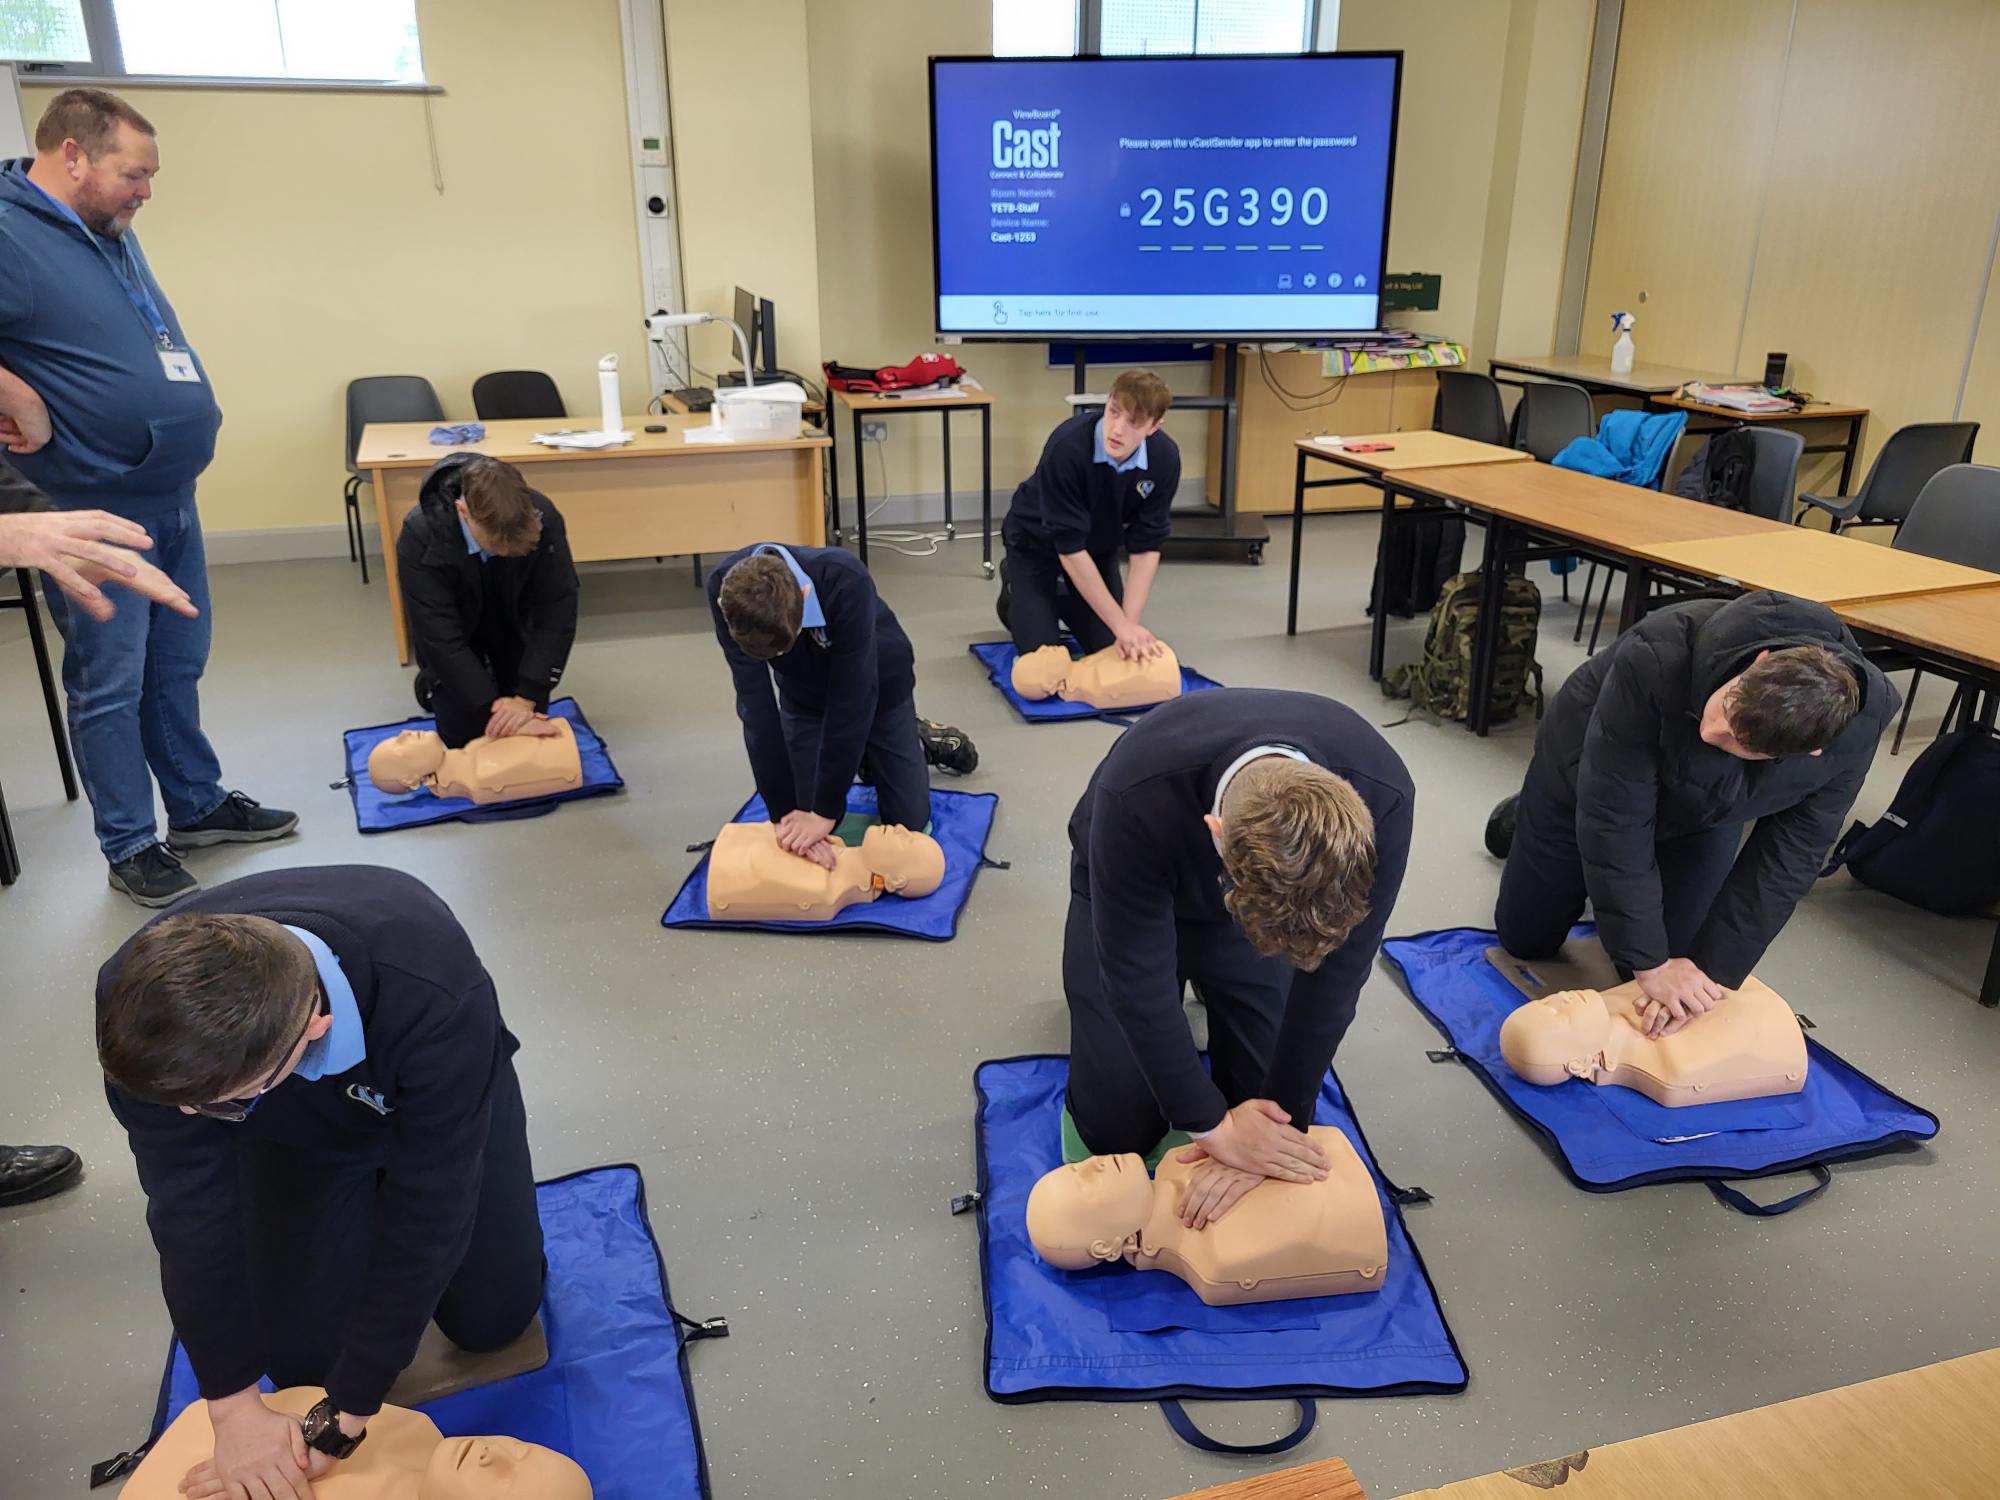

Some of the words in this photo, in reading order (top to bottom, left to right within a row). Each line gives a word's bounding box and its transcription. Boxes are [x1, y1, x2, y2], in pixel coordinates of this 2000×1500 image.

[992, 120, 1061, 169] Cast
[1119, 137, 1149, 149] Please
[1149, 139, 1172, 150] open
[1173, 138, 1188, 148] the
[1244, 138, 1262, 150] app
[1262, 137, 1273, 148] to
[1273, 137, 1297, 148] enter
[1298, 136, 1313, 148] the
[1312, 135, 1358, 149] password
[1139, 186, 1328, 227] 25G390
